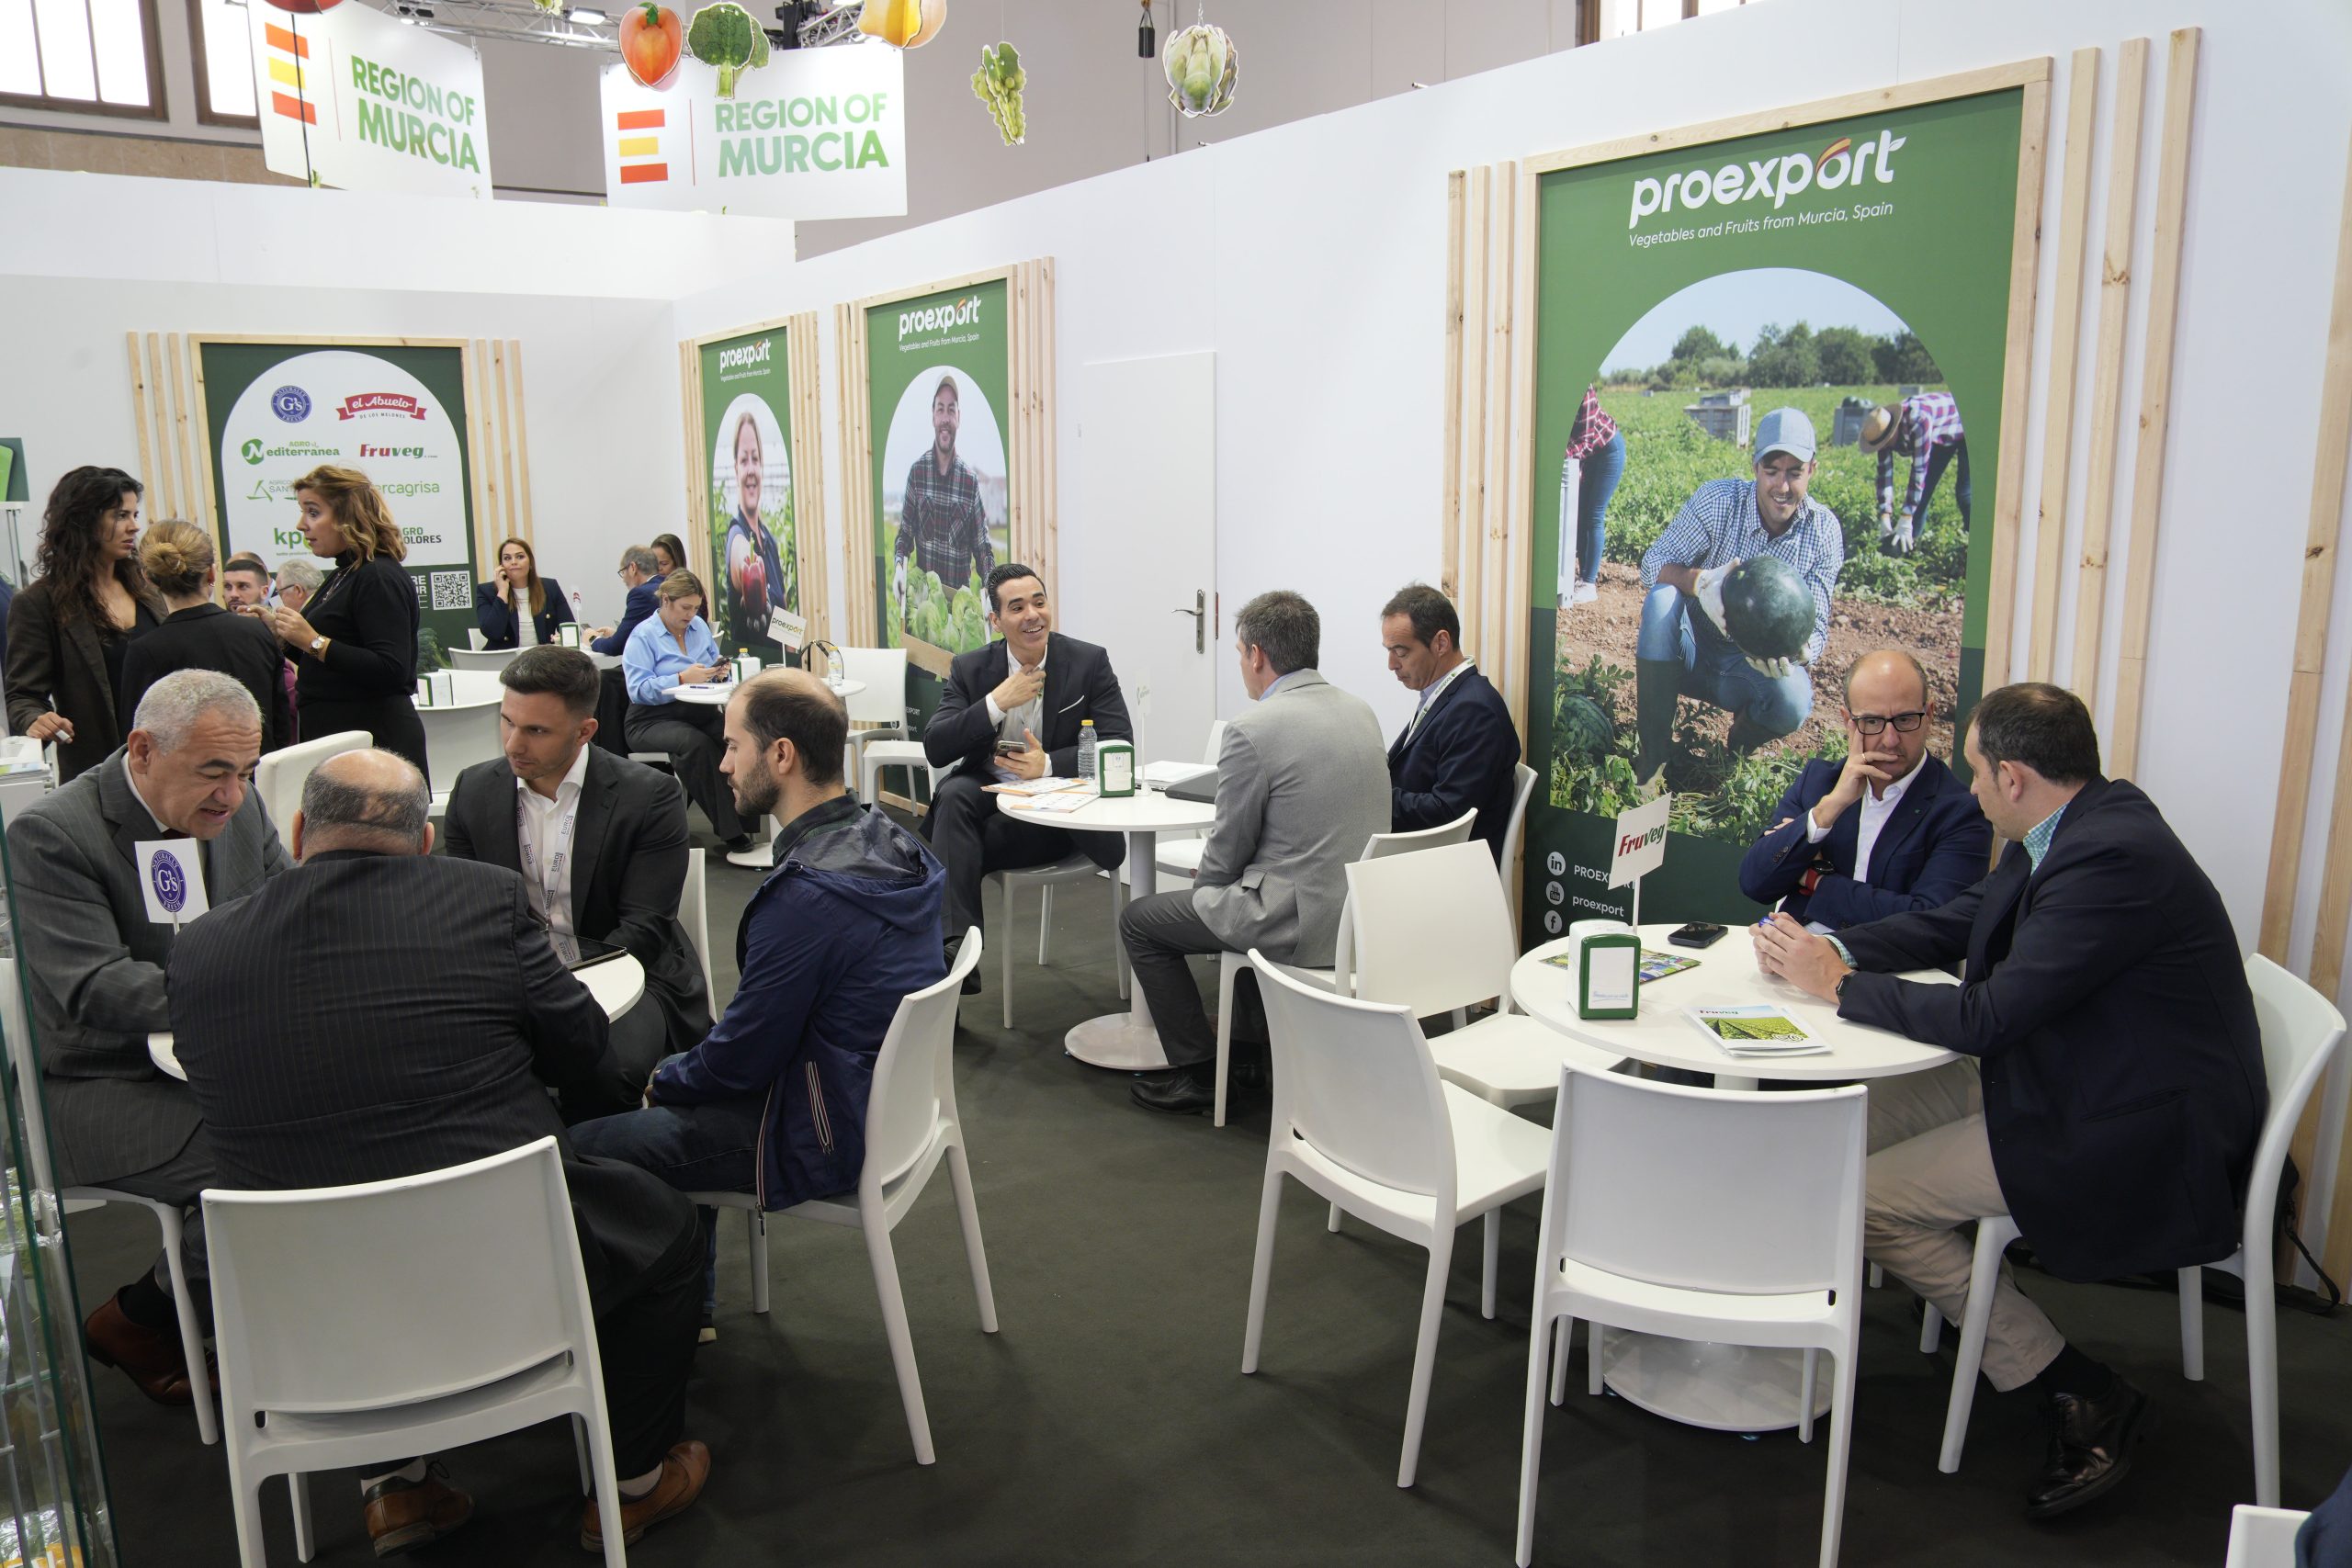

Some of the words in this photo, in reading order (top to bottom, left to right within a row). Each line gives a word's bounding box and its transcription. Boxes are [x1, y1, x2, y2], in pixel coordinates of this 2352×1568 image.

[351, 54, 443, 117] REGION
[447, 91, 475, 126] OF
[715, 96, 838, 133] REGION
[843, 93, 888, 124] OF
[358, 97, 481, 175] MURCIA
[718, 130, 889, 177] MURCIA
[1628, 130, 1907, 230] proexport
[1628, 227, 1695, 248] Vegetables
[1697, 222, 1722, 239] and
[1725, 217, 1759, 234] Fruits
[1762, 215, 1794, 231] from
[1798, 207, 1849, 225] Murcia,
[1852, 201, 1894, 221] Spain
[899, 295, 982, 342] proexport
[719, 338, 772, 374] proexport
[352, 397, 363, 409] el
[365, 395, 413, 408] Abuelo
[359, 444, 424, 459] Fruveg
[377, 481, 440, 497] ercagrisa
[402, 526, 424, 536] GRO
[403, 536, 442, 545] OLORES
[772, 617, 804, 635] proexport
[1618, 823, 1666, 857] Fruveg
[1550, 856, 1562, 871] in
[1572, 896, 1624, 918] proexport
